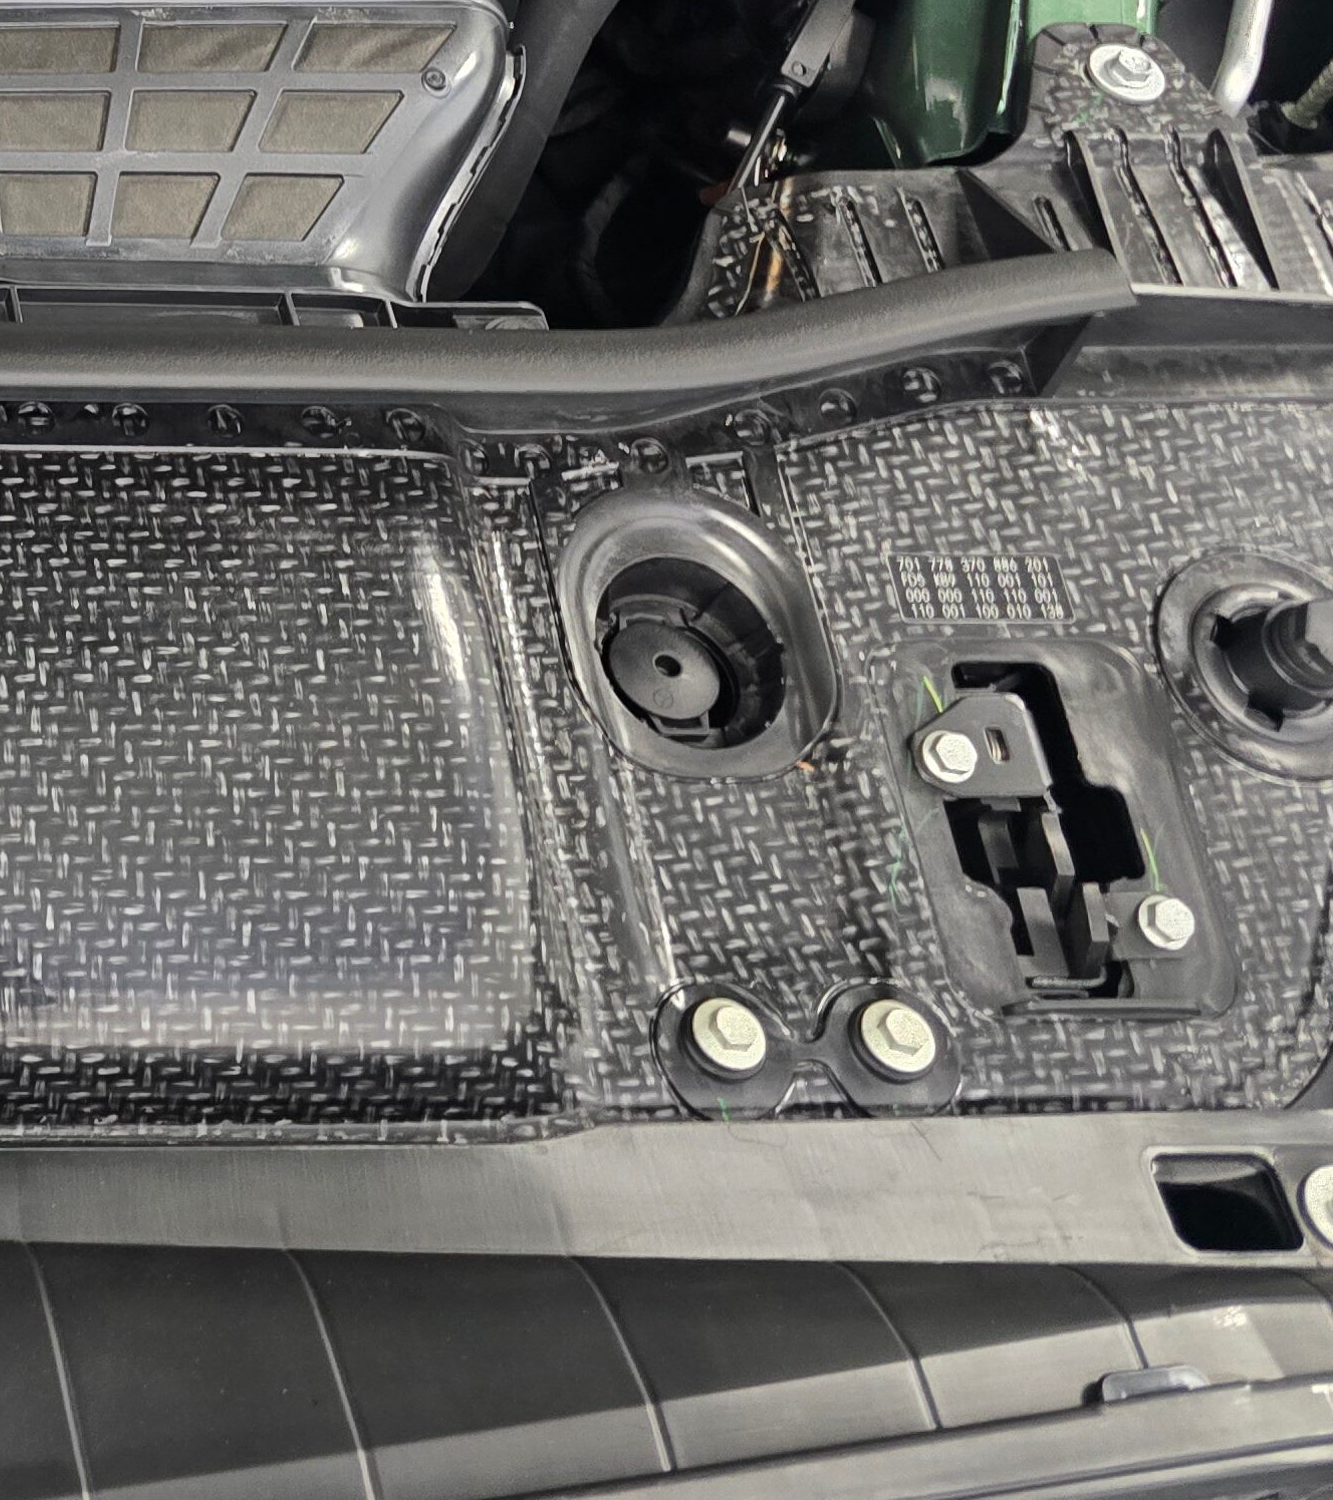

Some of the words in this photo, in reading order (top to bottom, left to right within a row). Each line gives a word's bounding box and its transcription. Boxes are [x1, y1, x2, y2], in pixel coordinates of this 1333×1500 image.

[897, 555, 920, 573] 701
[961, 555, 986, 573] 370
[967, 572, 990, 588] 110
[997, 572, 1022, 588] 001
[1031, 572, 1053, 588] 101
[905, 587, 931, 604] 000
[938, 587, 963, 604] 000
[971, 587, 995, 604] 110
[1003, 587, 1027, 604] 110
[1034, 587, 1059, 604] 001
[911, 603, 935, 620] 110
[942, 603, 967, 620] 001
[976, 603, 999, 620] 100
[1007, 603, 1032, 620] 010
